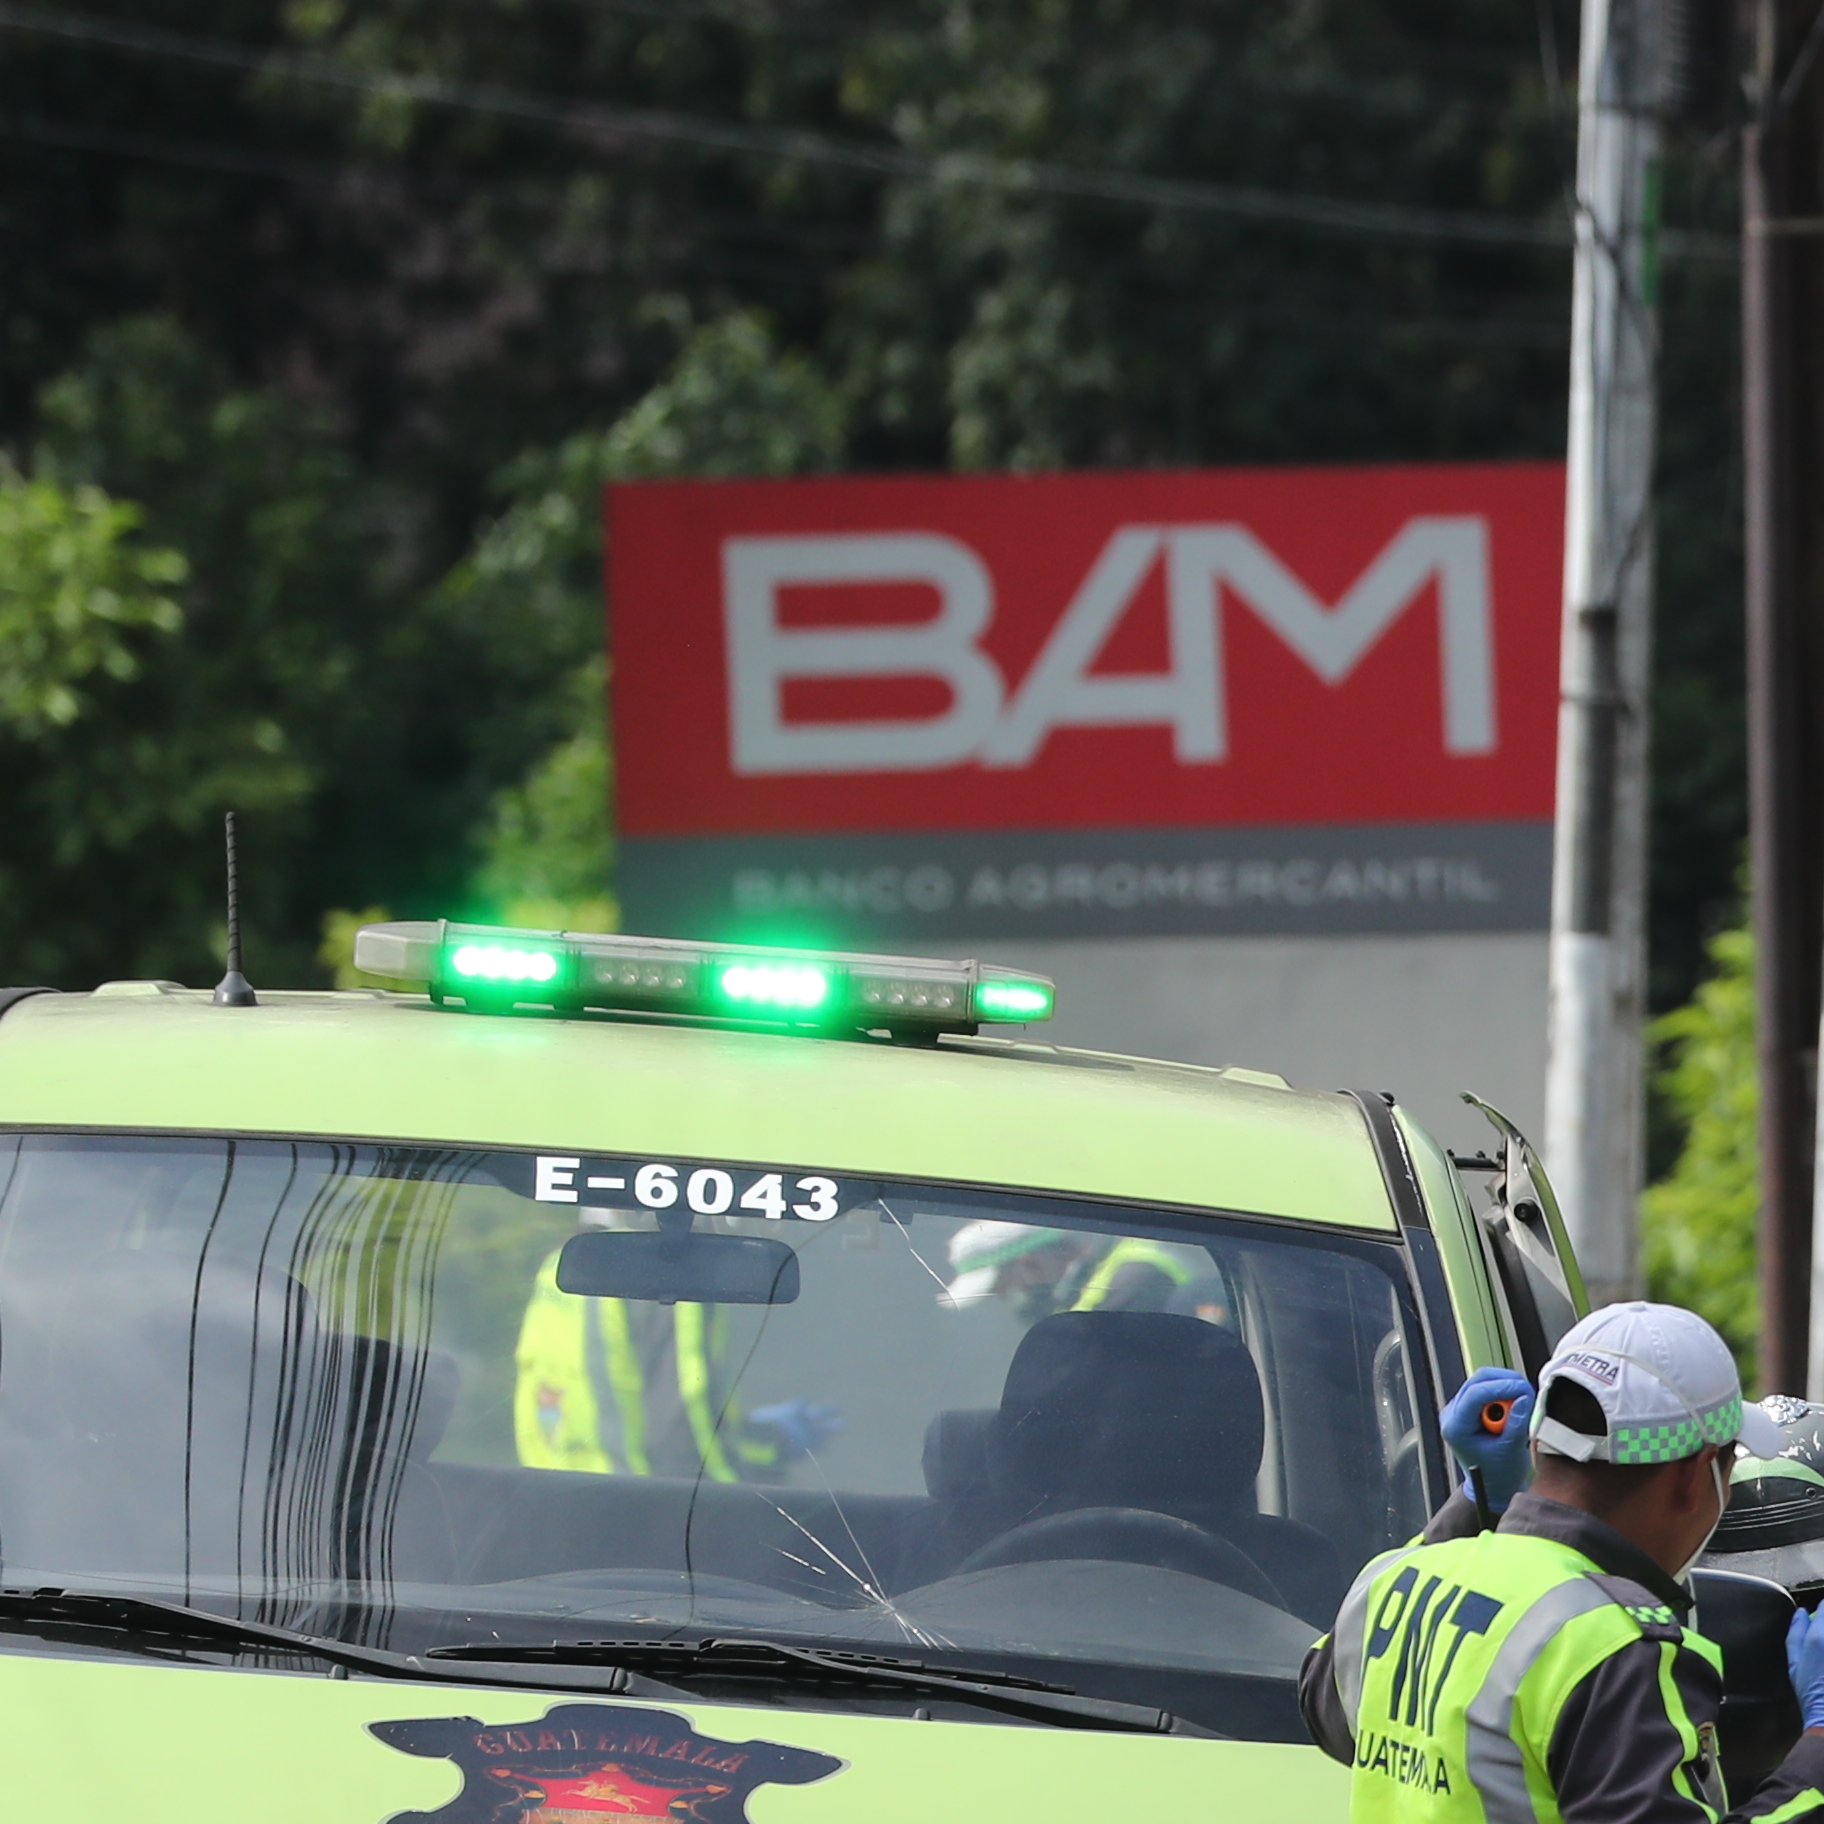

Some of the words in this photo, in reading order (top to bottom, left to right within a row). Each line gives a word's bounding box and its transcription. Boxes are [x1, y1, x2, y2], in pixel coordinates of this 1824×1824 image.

[720, 514, 1498, 776] BAM
[733, 863, 955, 912] BANCO
[965, 855, 1500, 908] AGROMERCANTIL
[535, 1156, 840, 1222] E-6043
[1360, 1565, 1505, 1738] PMT
[471, 1728, 751, 1774] GUATEMALA
